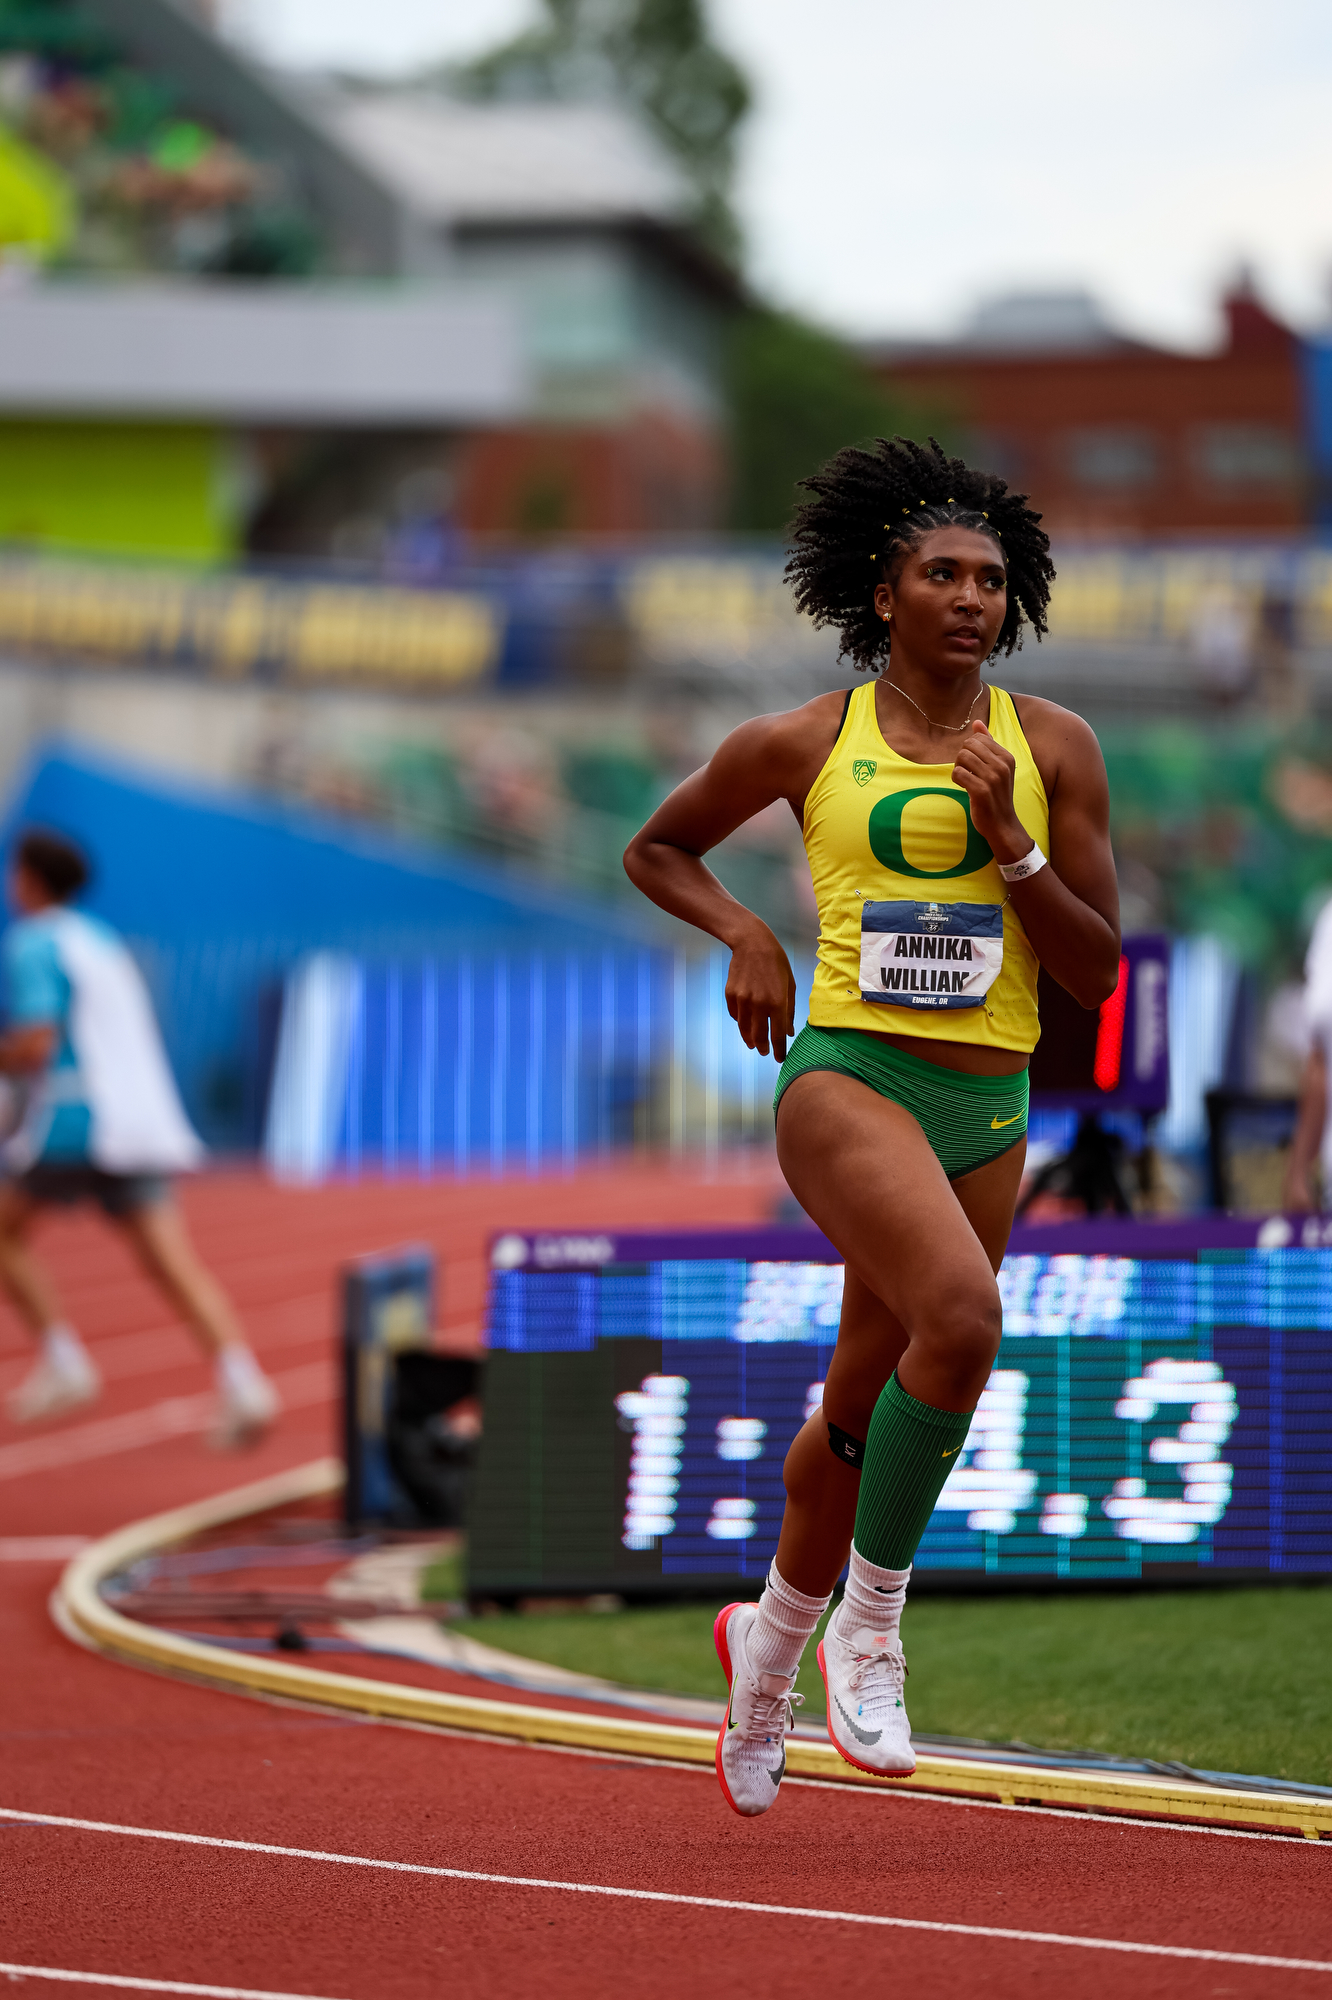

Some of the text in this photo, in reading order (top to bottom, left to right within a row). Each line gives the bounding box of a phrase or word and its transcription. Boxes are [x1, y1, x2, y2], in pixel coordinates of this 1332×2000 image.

[855, 762, 876, 777] PAC
[857, 772, 869, 781] 12
[869, 787, 995, 879] O
[894, 935, 973, 961] ANNIKA
[912, 996, 949, 1005] EUGENE, OR
